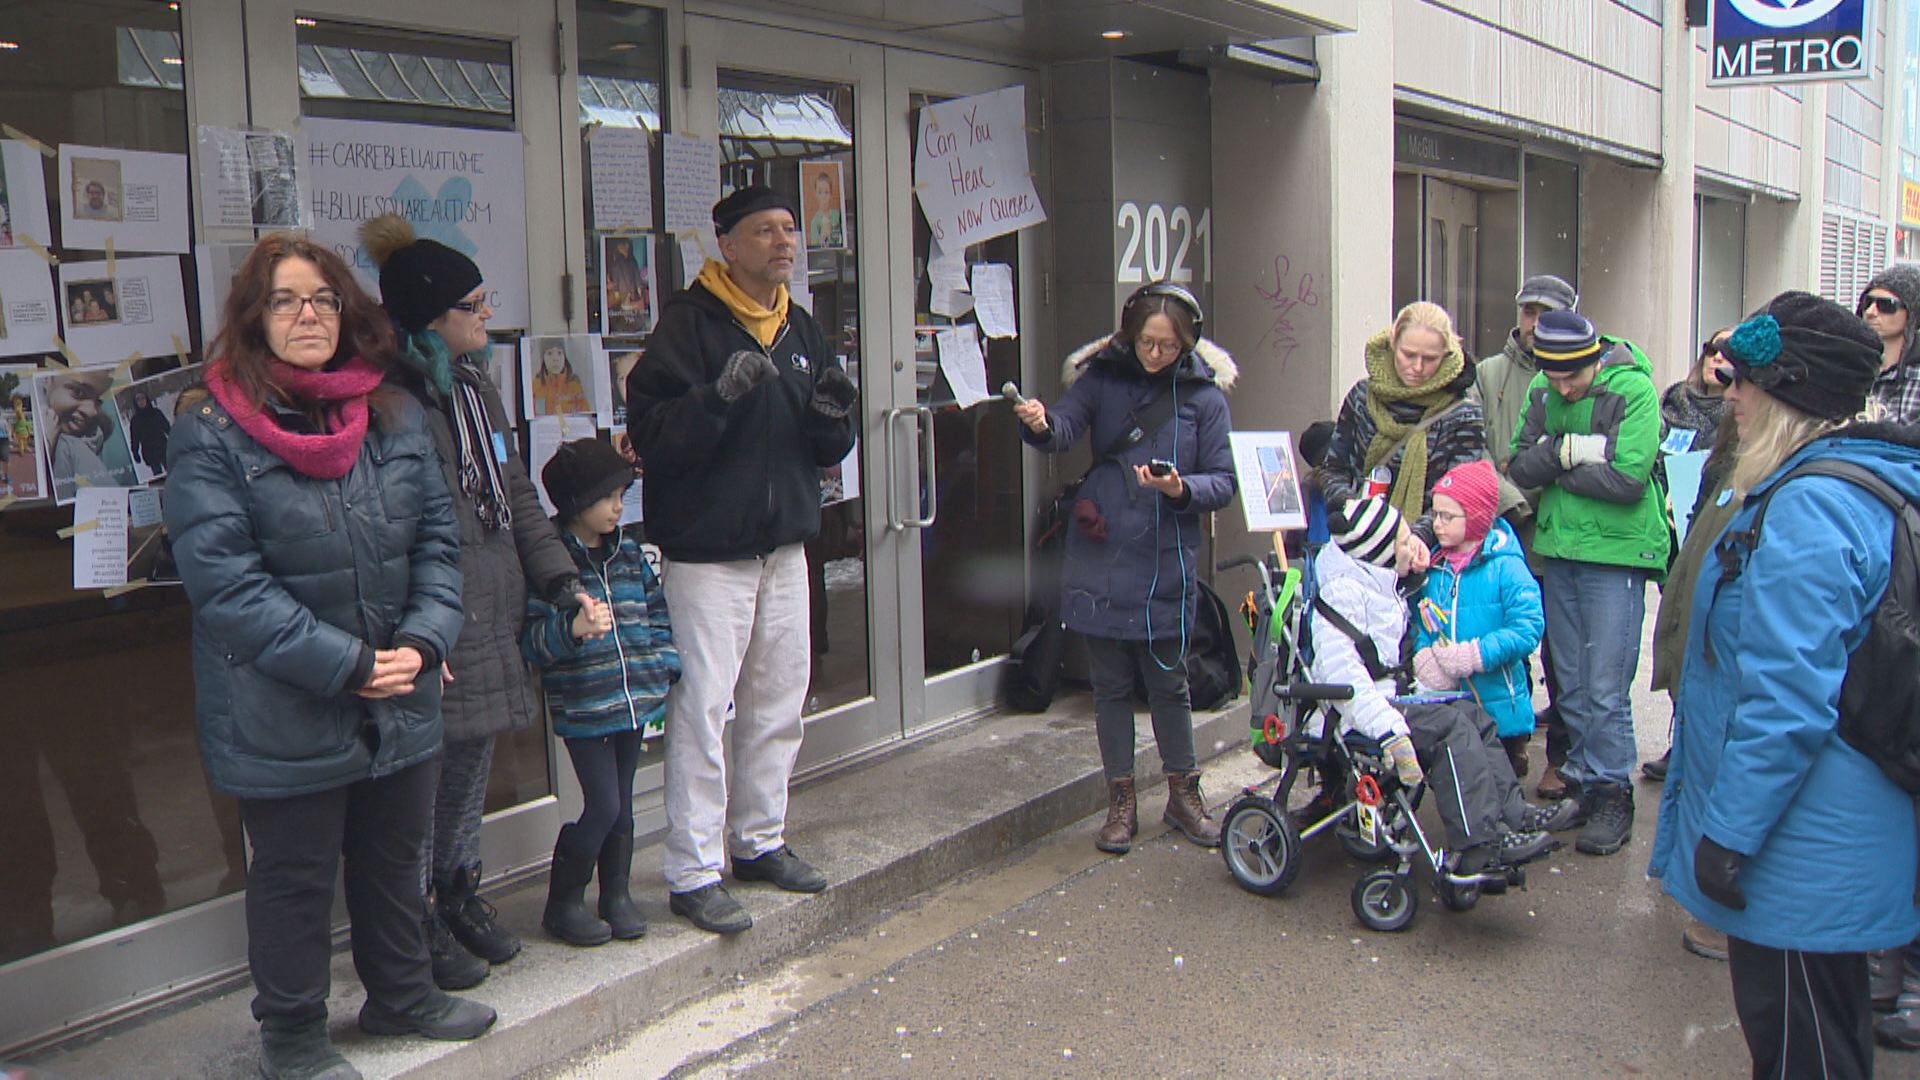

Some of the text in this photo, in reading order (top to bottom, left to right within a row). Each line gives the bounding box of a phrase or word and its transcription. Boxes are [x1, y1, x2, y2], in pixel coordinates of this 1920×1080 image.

[925, 104, 993, 158] Can You
[949, 156, 995, 197] Hear
[1117, 202, 1211, 283] 2021
